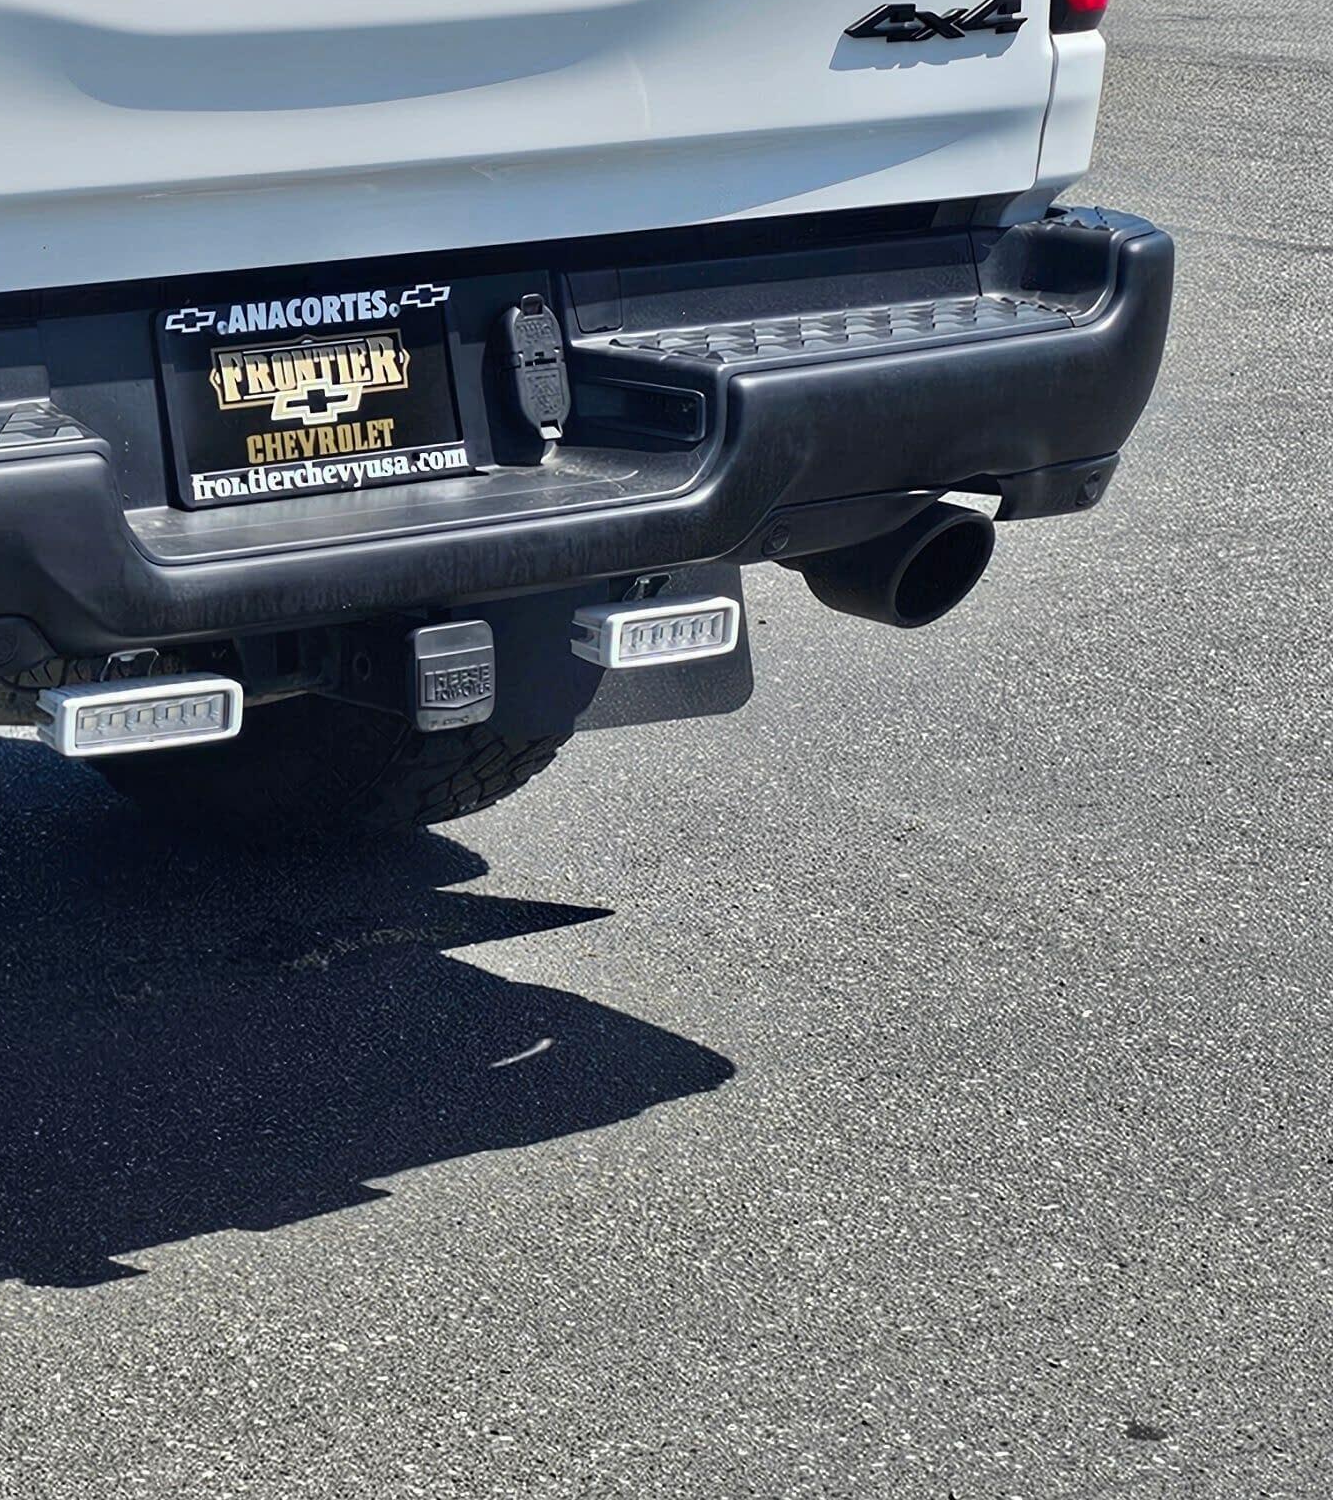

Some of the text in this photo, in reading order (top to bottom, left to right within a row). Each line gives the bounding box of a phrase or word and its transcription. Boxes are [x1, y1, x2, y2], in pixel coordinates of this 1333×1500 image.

[228, 290, 390, 334] ANACORTES
[217, 336, 403, 403] FRONTIER
[246, 418, 394, 465] CHEVROLET
